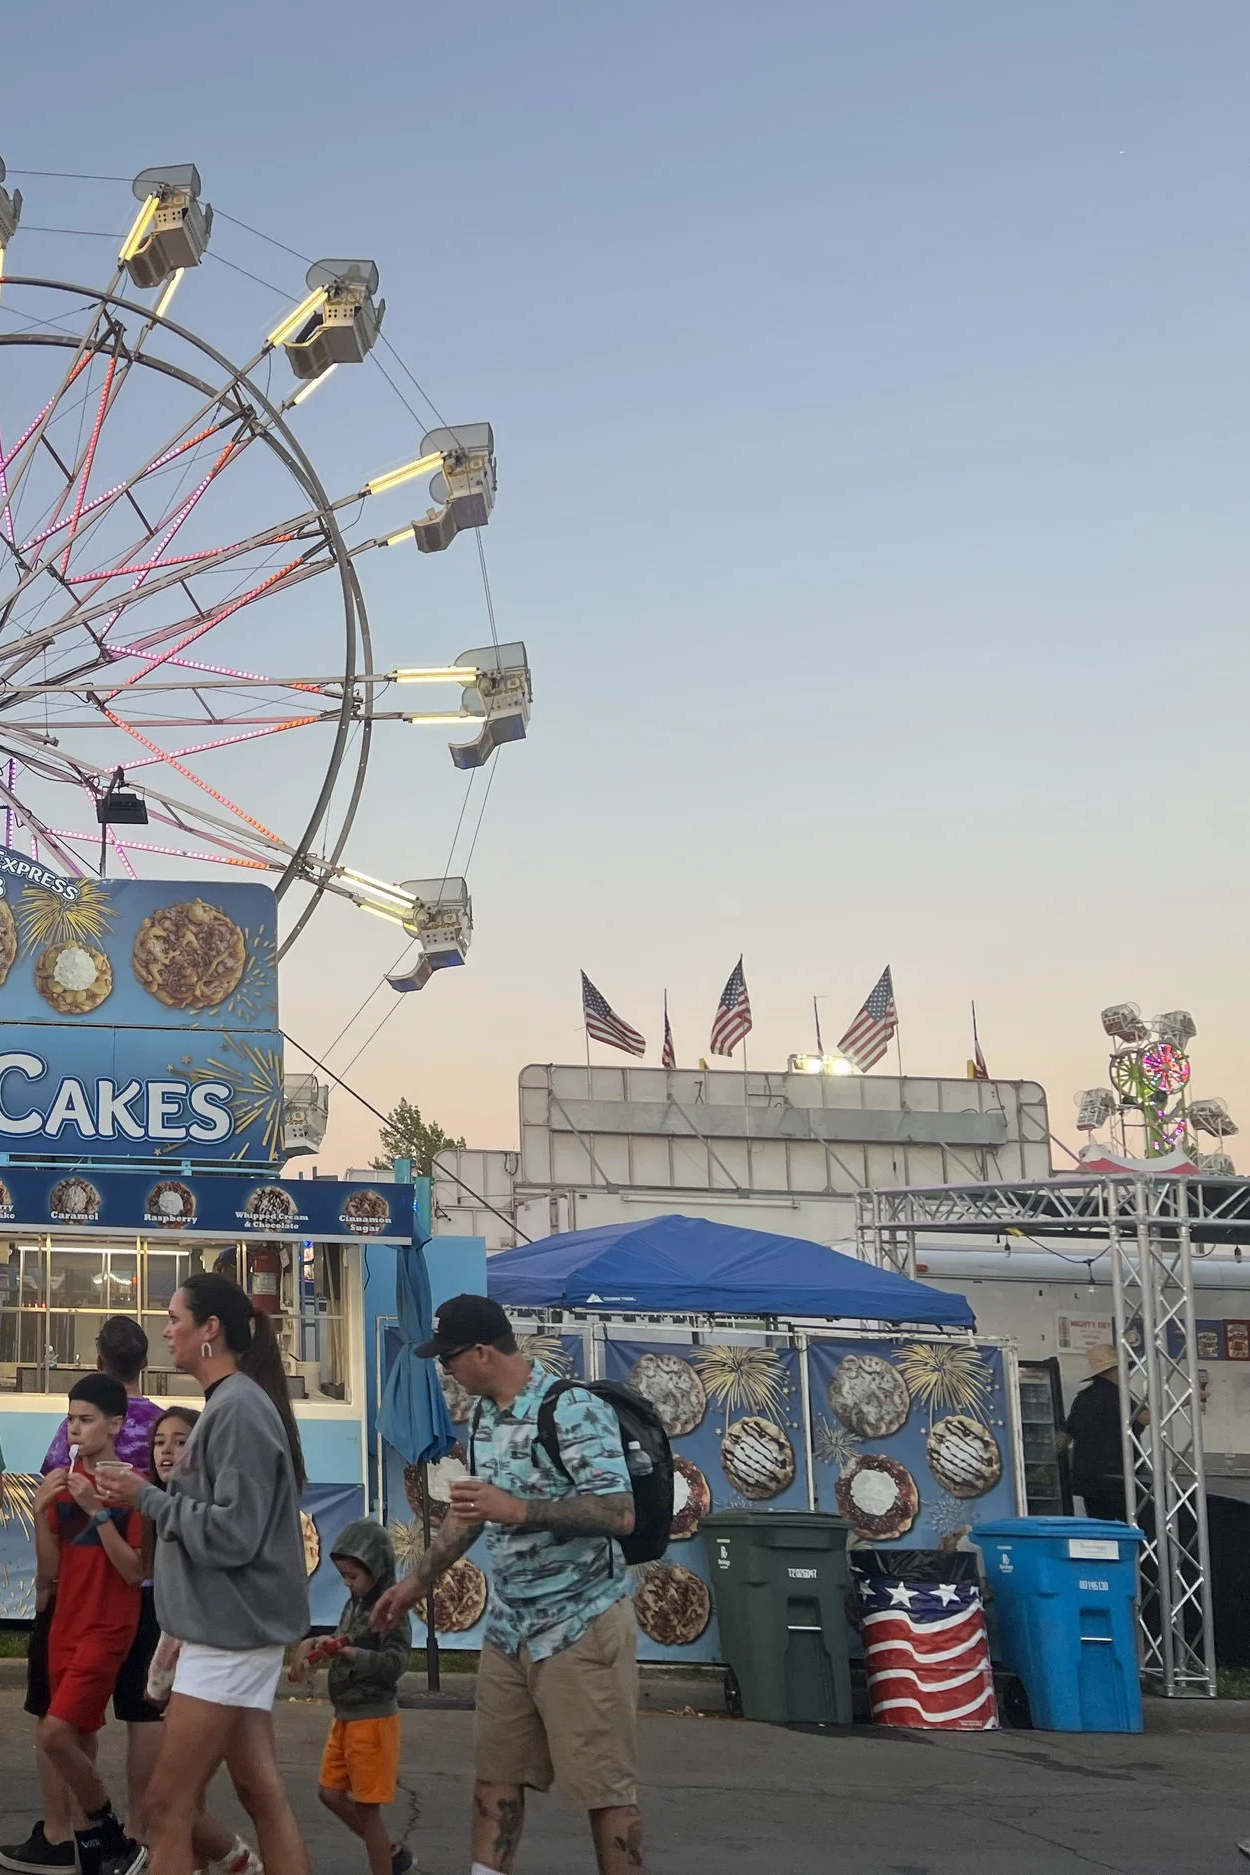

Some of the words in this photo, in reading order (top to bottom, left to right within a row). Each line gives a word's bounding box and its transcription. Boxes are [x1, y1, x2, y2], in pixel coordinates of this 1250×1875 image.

[50, 1211, 99, 1221] Caramel
[143, 1213, 198, 1224] Raspberry
[235, 1211, 277, 1221] Whipped
[278, 1213, 309, 1221] Cream
[338, 1215, 392, 1224] Cinnamon
[252, 1221, 299, 1230] Chocolate
[350, 1224, 381, 1233] Sugar
